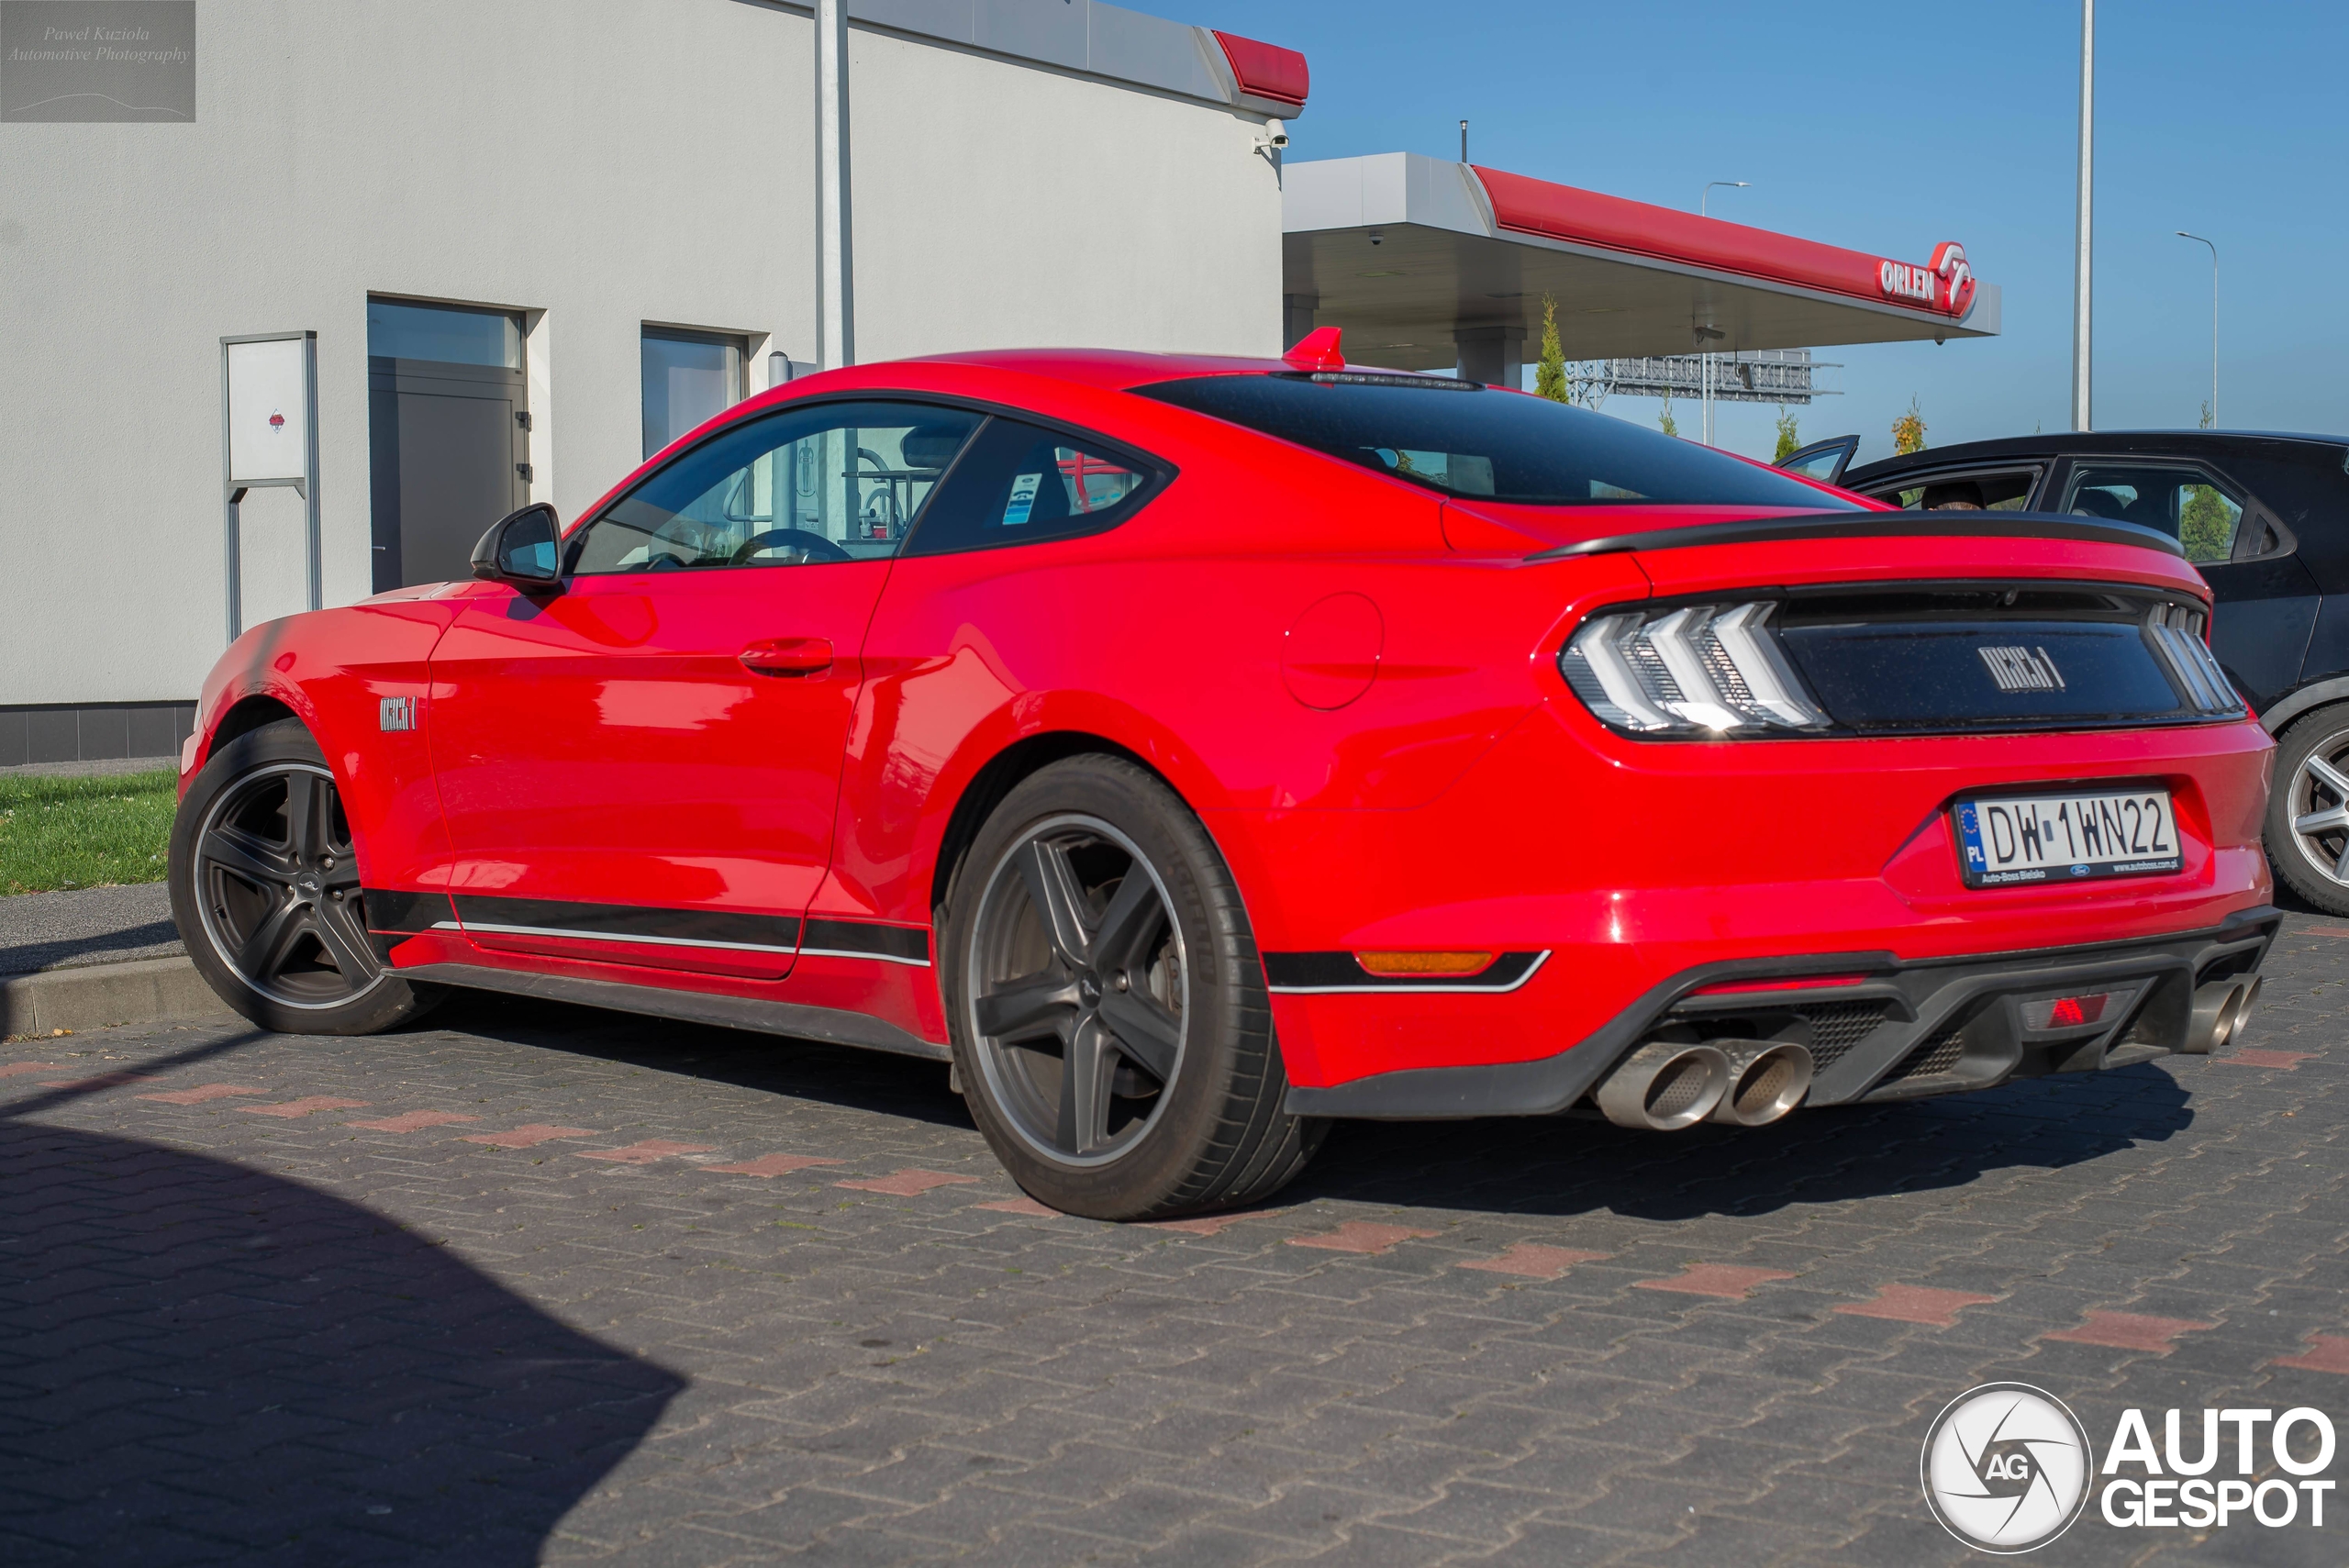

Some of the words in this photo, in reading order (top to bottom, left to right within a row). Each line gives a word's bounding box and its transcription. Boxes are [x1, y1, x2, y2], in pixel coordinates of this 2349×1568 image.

[1881, 261, 1934, 301] ORLEN
[1987, 804, 2043, 864] DW
[2058, 797, 2169, 858] 1WN22
[1966, 846, 1985, 862] PL
